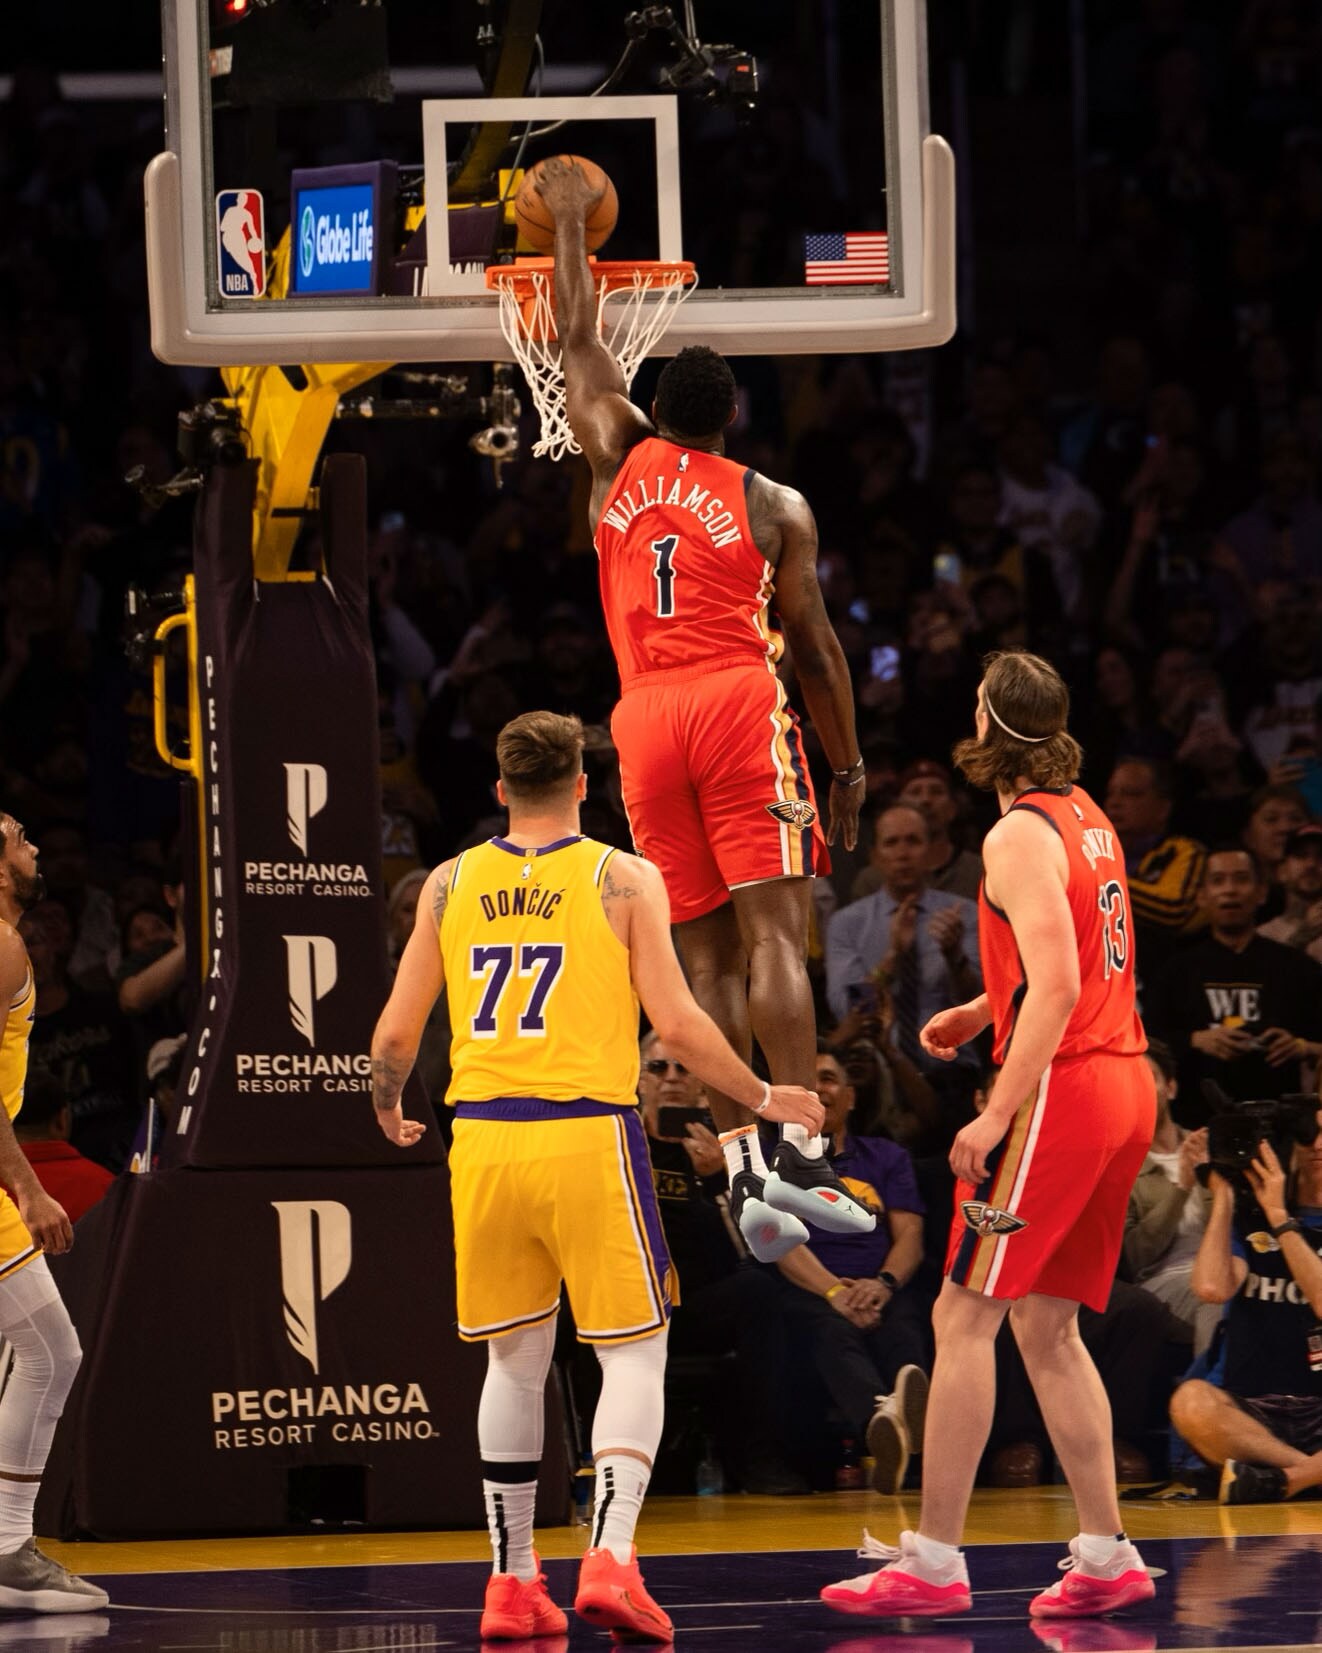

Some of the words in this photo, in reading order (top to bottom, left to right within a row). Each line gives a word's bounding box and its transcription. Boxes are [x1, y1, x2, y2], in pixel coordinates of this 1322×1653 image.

[316, 213, 350, 265] Globe
[351, 208, 373, 262] Life
[226, 274, 249, 291] NBA
[602, 475, 742, 549] WILLIAMSON
[651, 534, 680, 618] 1
[244, 861, 369, 883] PECHANGA
[245, 882, 306, 896] RESORT
[480, 883, 567, 923] DONČIĆ
[1098, 879, 1129, 981] 13
[470, 942, 566, 1040] 77
[1204, 987, 1262, 1022] WE
[235, 1053, 371, 1076] PECHANG
[237, 1078, 313, 1094] RESORT
[322, 1078, 374, 1093] CASI
[211, 1382, 431, 1423] PECHANGA
[214, 1423, 318, 1449] RESORT
